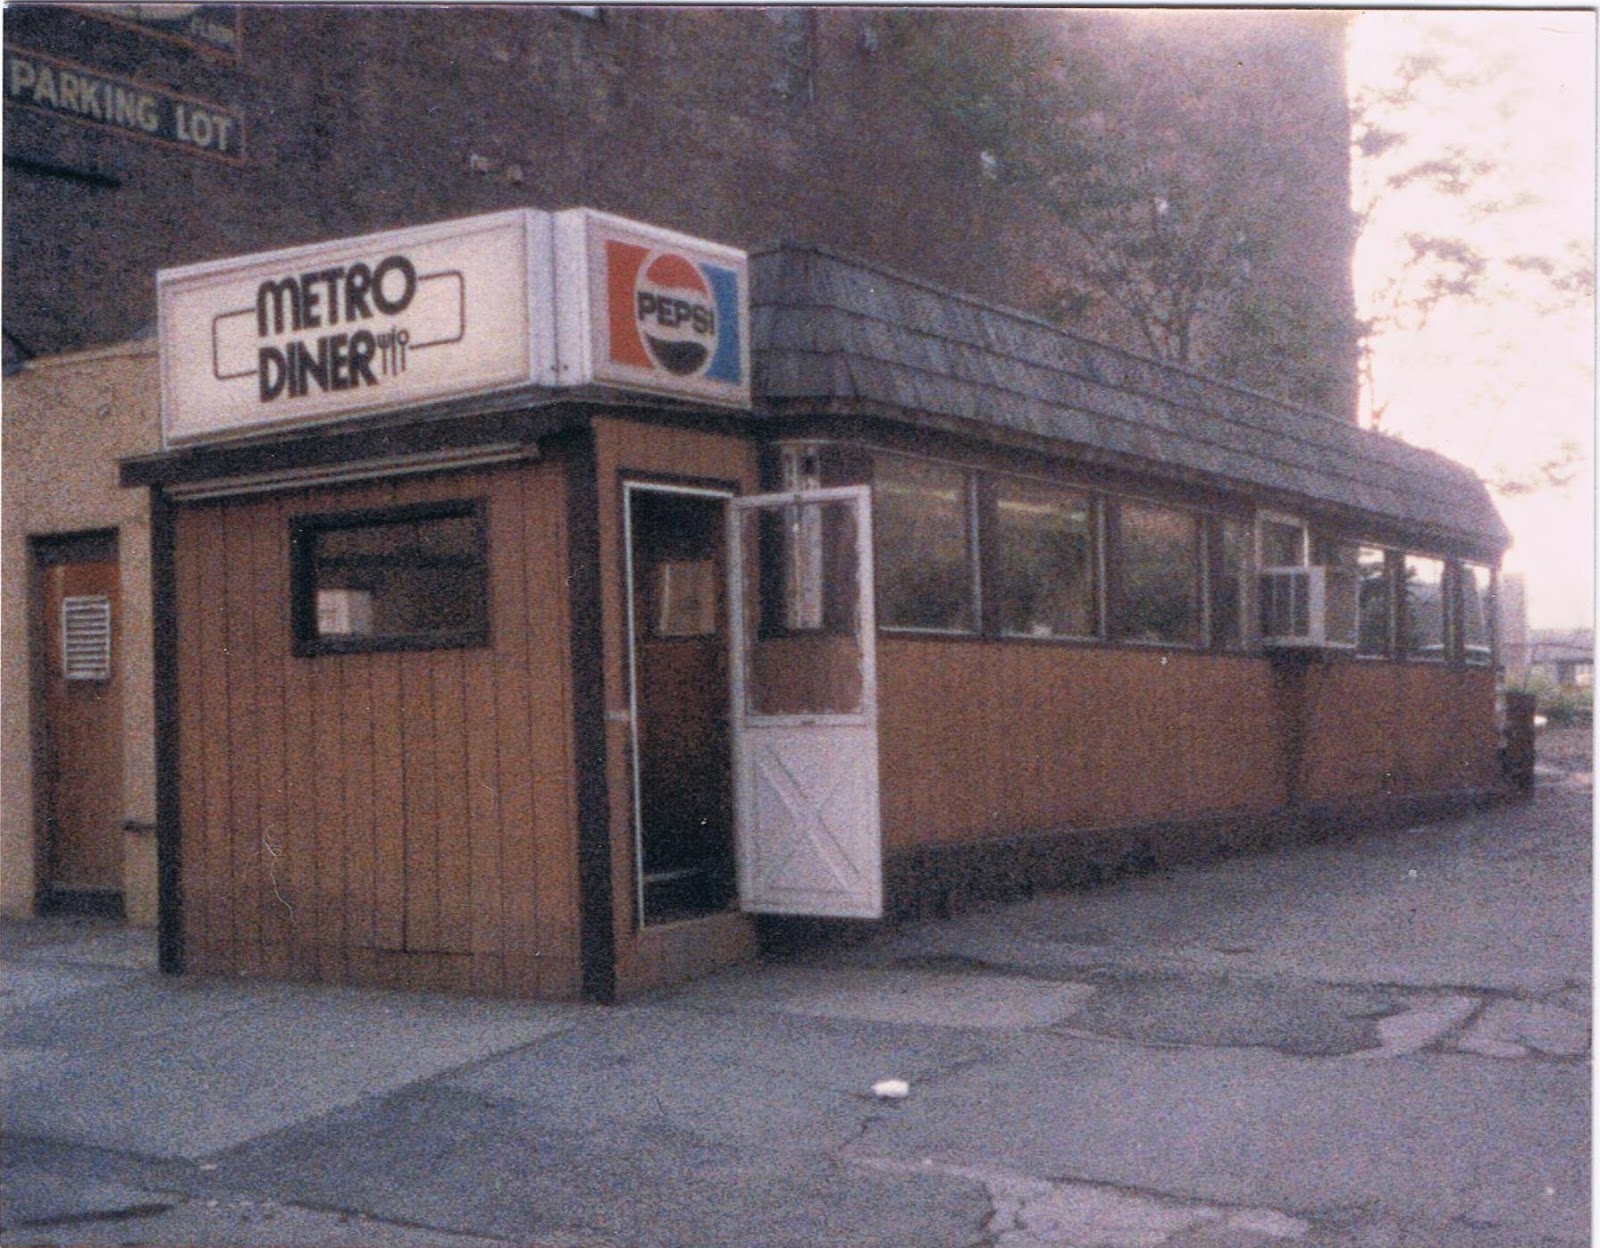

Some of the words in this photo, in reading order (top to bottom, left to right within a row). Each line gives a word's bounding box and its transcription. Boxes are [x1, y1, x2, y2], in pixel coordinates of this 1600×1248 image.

[9, 58, 159, 132] PARKING
[174, 104, 232, 151] LOT
[256, 254, 417, 337] METRO
[636, 290, 716, 336] PEPSI
[258, 329, 378, 403] DINER
